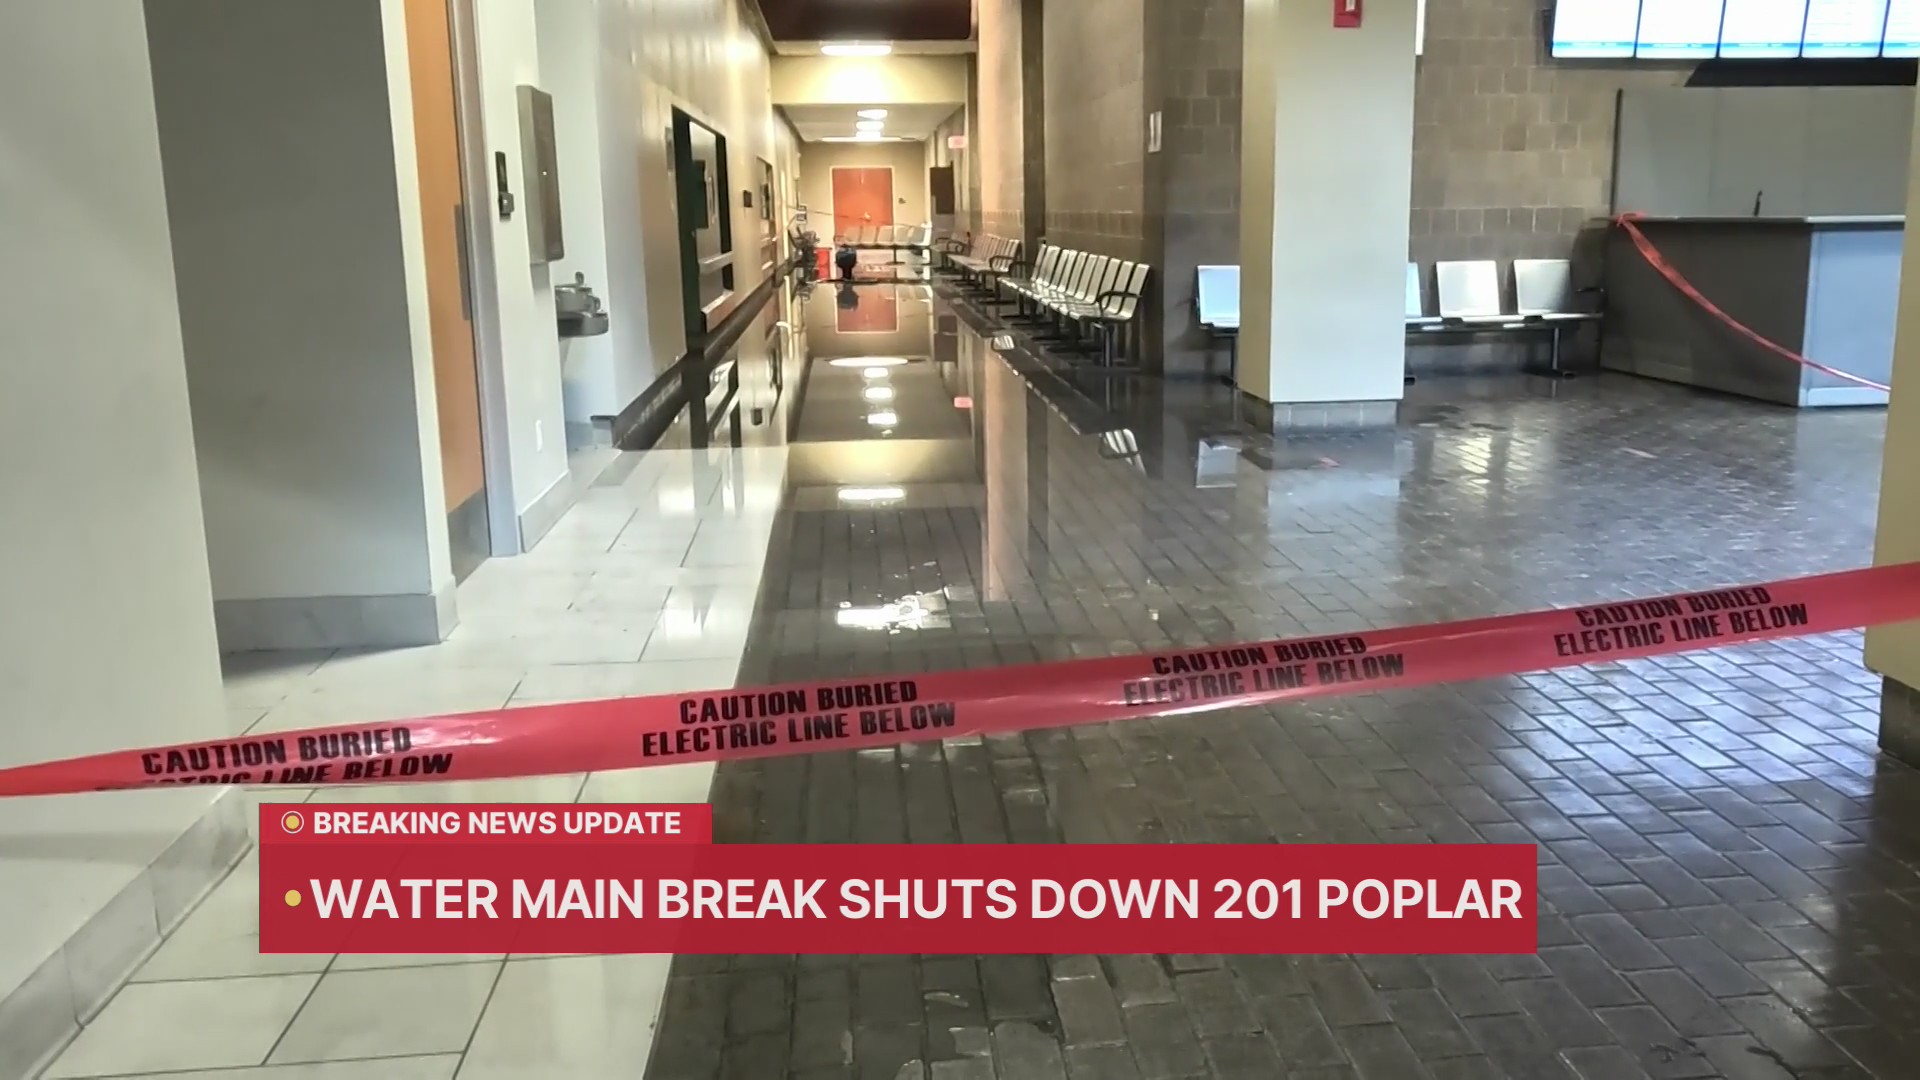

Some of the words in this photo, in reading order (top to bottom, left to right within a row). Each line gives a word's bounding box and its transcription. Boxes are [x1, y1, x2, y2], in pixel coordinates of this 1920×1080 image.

[1554, 622, 1665, 657] ELECTRIC
[1670, 615, 1724, 642] LINE
[1728, 603, 1808, 634] BELOW
[1575, 599, 1684, 628] CAUTION
[1685, 587, 1772, 614] BURIED
[1123, 672, 1245, 706] ELECTRIC
[1253, 664, 1307, 692] LINE
[1316, 653, 1405, 686] BELOW
[1152, 647, 1268, 675] CAUTION
[1273, 637, 1367, 662] BURIED
[680, 689, 807, 725] CAUTION
[818, 680, 918, 711] BURIED
[141, 739, 287, 776] CAUTION
[297, 727, 412, 761] BURIED
[642, 721, 777, 757] ELECTRIC
[788, 713, 850, 743] LINE
[860, 702, 956, 735] BELOW
[342, 753, 453, 780] BELOW
